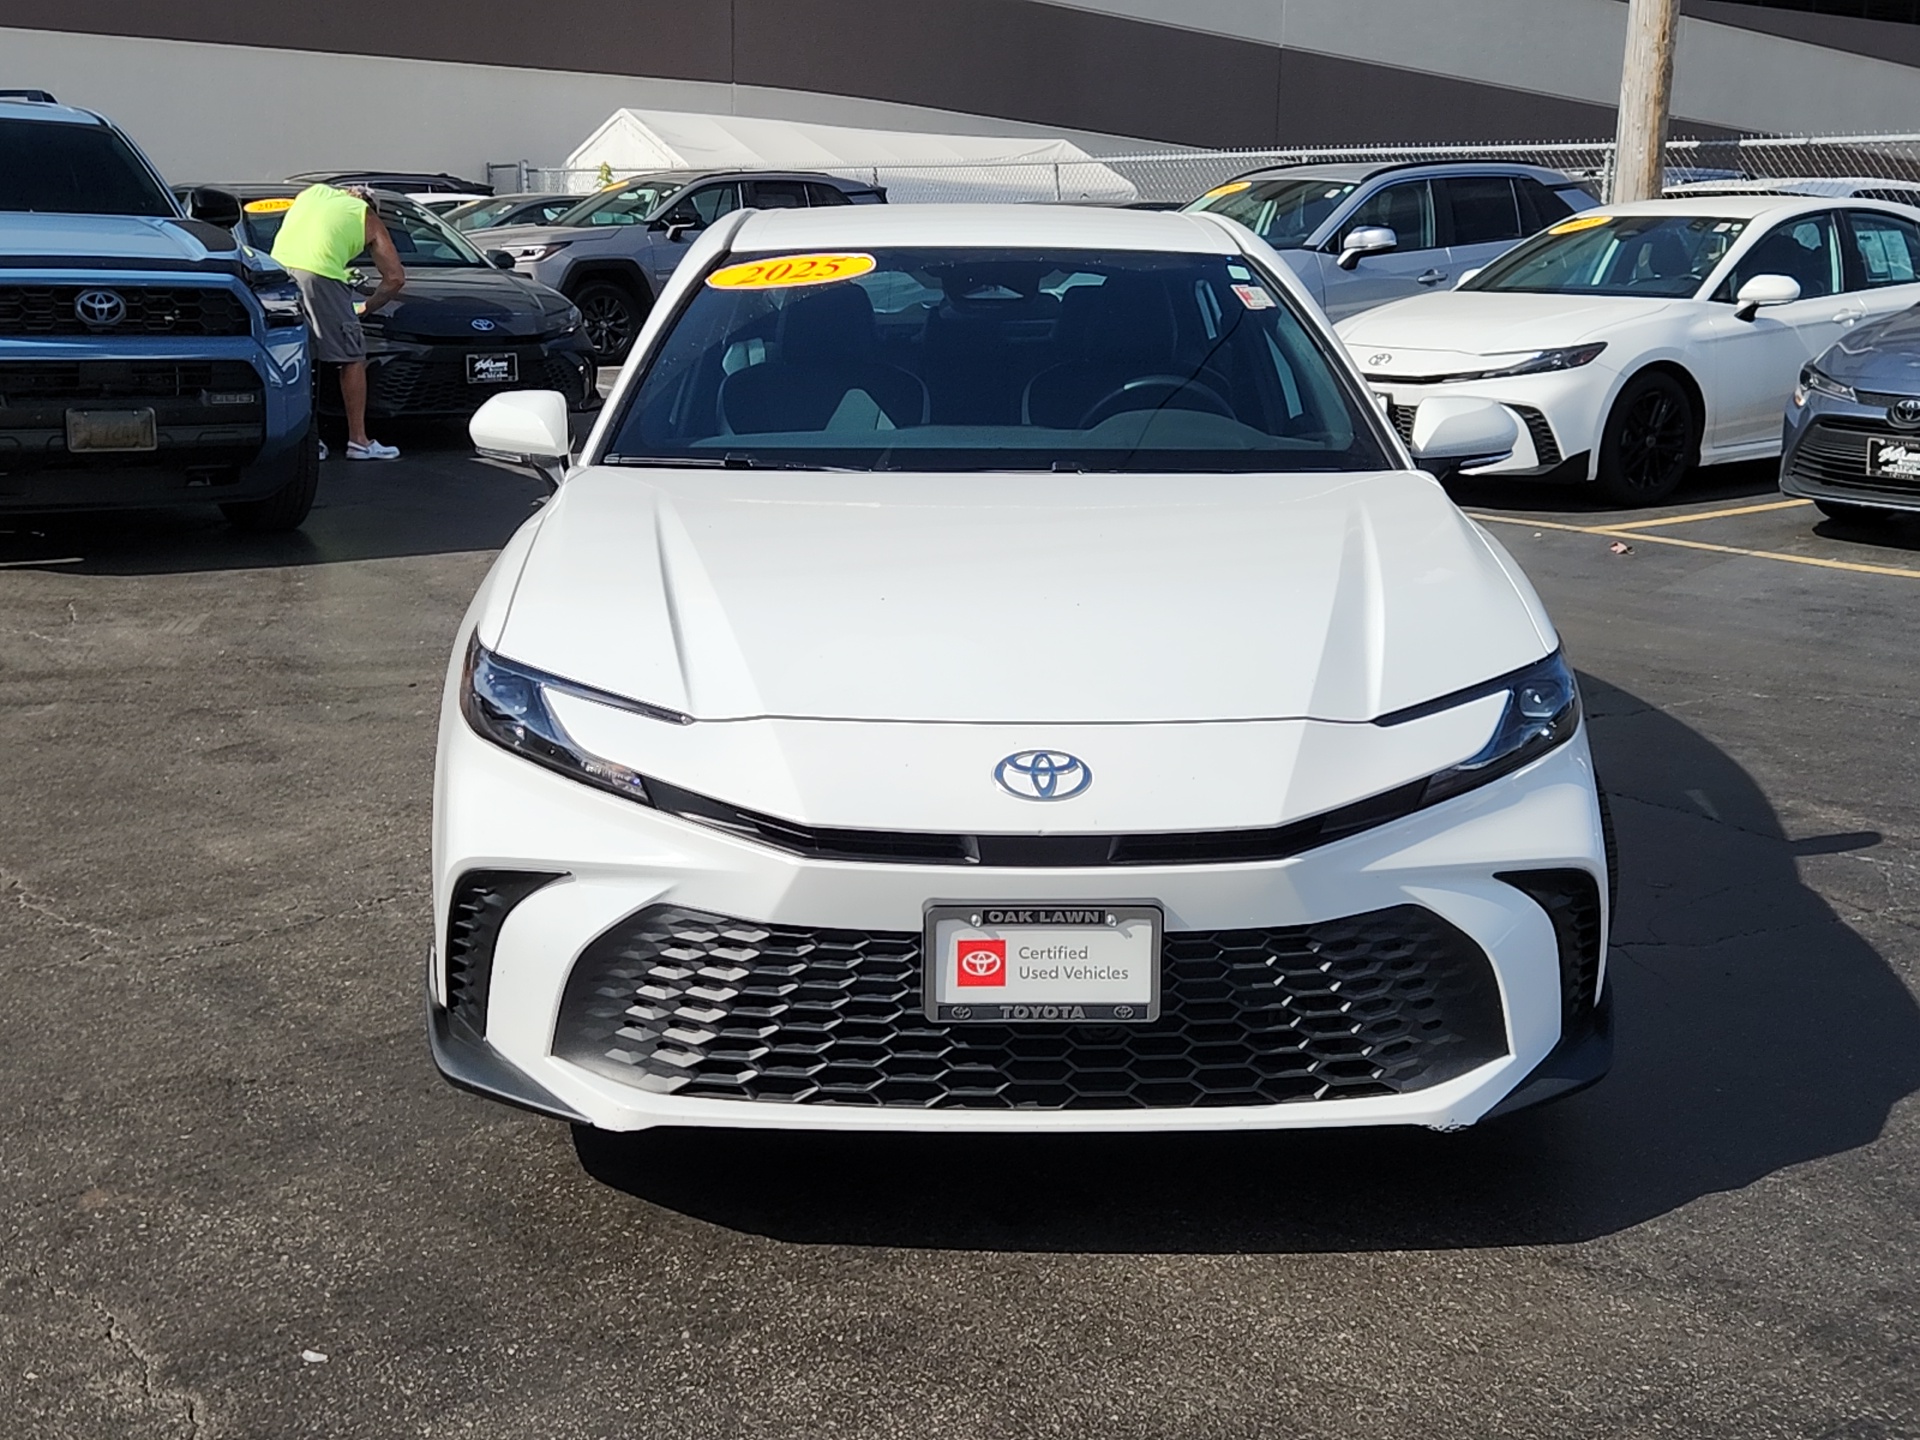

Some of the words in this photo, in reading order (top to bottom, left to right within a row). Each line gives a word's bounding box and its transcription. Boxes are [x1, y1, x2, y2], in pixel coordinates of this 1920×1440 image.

[735, 257, 847, 285] 2025
[988, 910, 1033, 923] OAK
[1039, 910, 1100, 923] LAWN
[1018, 946, 1089, 960] Certified
[1018, 965, 1059, 980] Used
[1063, 965, 1129, 980] Vehicles
[999, 1005, 1087, 1020] TOYOTA
